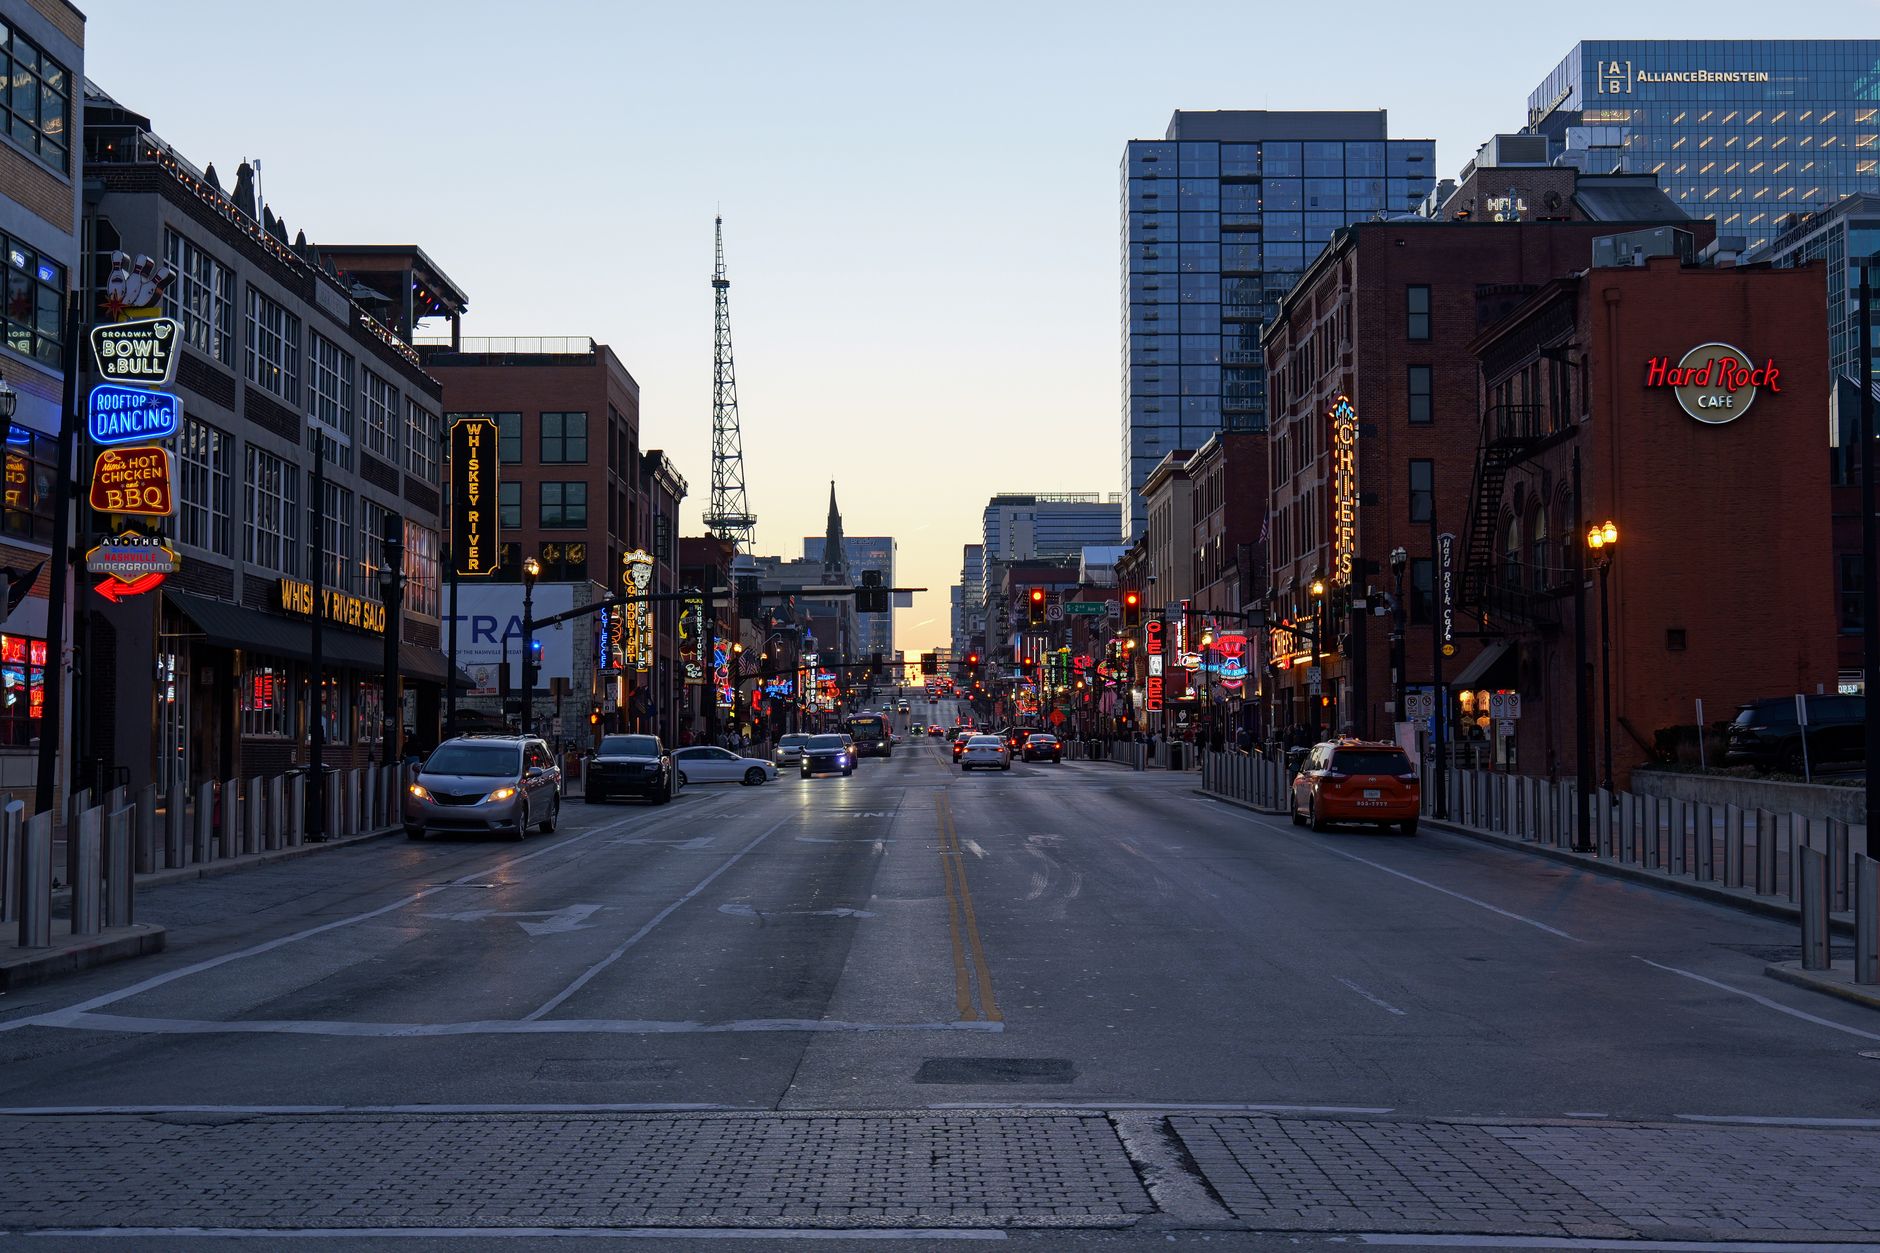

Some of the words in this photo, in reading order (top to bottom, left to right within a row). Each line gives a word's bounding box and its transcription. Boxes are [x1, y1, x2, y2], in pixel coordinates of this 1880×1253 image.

[1609, 61, 1620, 74] A
[1610, 81, 1620, 93] B
[102, 340, 166, 357] BOWL
[1647, 355, 1716, 388] Hard
[1717, 357, 1782, 393] Rock
[97, 394, 147, 411] ROOFTOP
[1698, 395, 1734, 409] CAFE
[97, 407, 171, 436] DANCING
[129, 455, 158, 469] HOT
[466, 423, 482, 506] WHISKEY
[101, 467, 162, 484] CHICKEN
[105, 486, 163, 509] BBQ
[1339, 424, 1352, 574] CHIEFS
[102, 538, 119, 546] AT
[133, 538, 159, 546] THE
[468, 511, 480, 570] RIVER
[89, 562, 173, 571] UNDERGROUND
[104, 553, 157, 562] NASHVILLE
[1443, 571, 1451, 605] Rock
[281, 577, 330, 619] WHISY
[333, 591, 361, 628] RIVER
[363, 601, 386, 634] SALO
[626, 586, 636, 663] GODNIGHT
[1147, 621, 1162, 654] OLE
[810, 654, 818, 702] FRIENDS
[1148, 677, 1162, 710] RED
